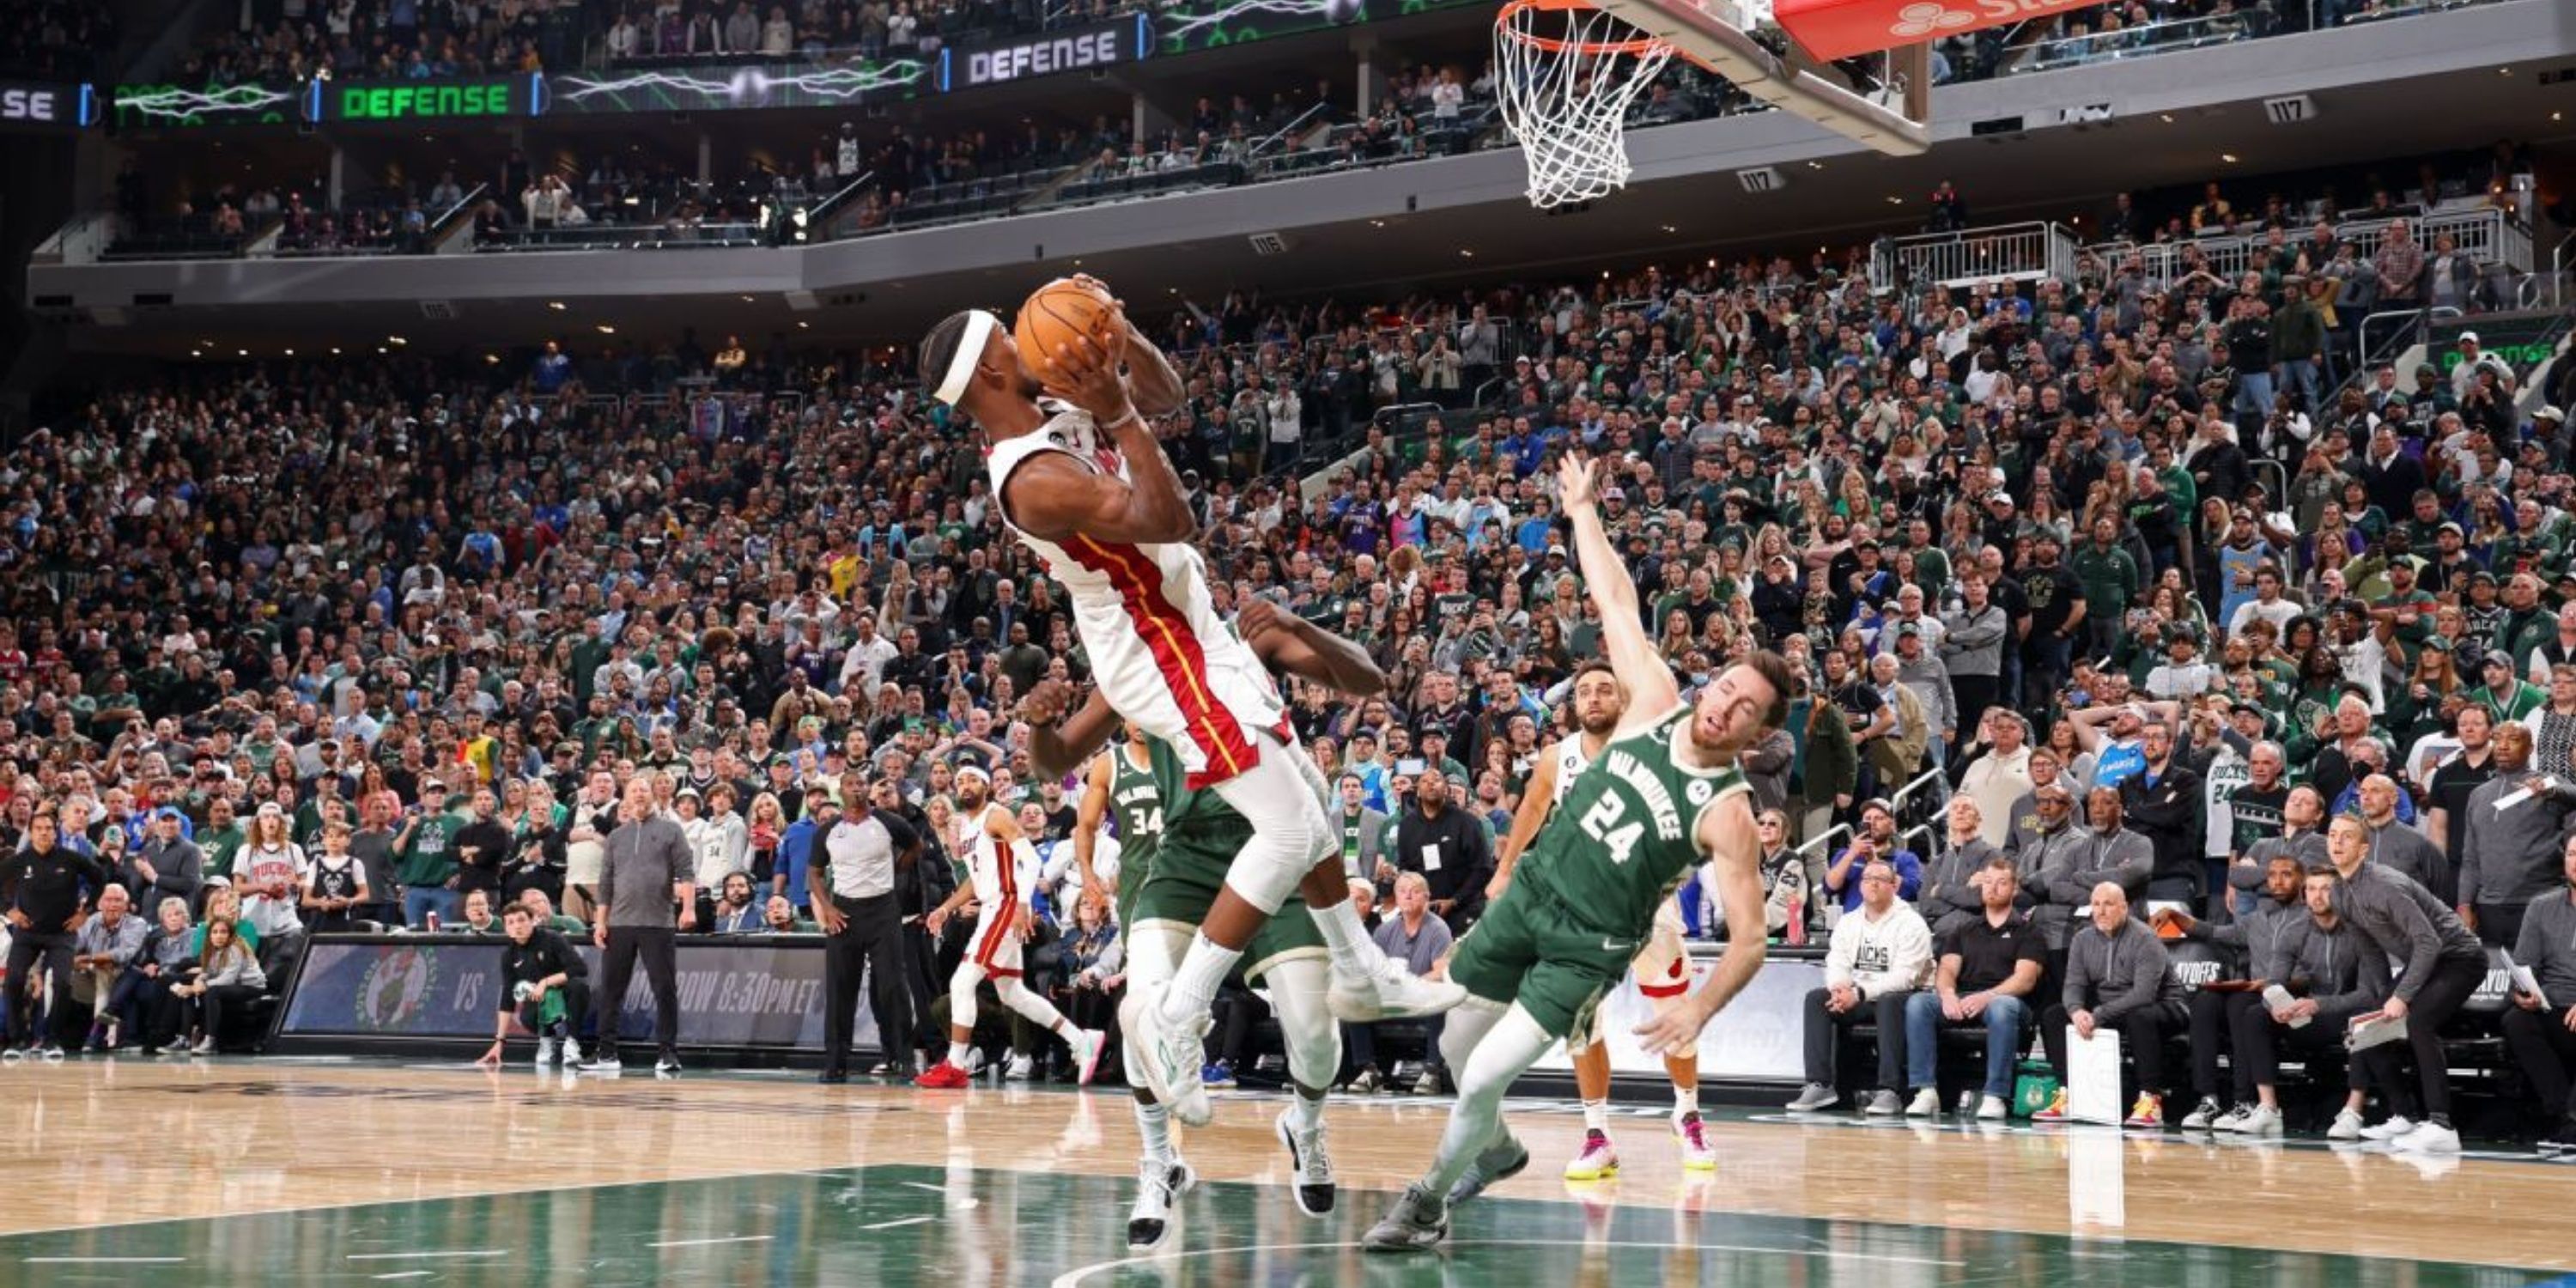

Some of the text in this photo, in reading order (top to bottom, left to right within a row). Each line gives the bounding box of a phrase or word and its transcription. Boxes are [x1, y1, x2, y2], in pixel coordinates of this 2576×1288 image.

[969, 31, 1116, 83] DEFENSE
[343, 84, 509, 118] DEFENSE
[2271, 99, 2301, 121] 117
[1743, 171, 1770, 190] 117
[1255, 236, 1281, 254] 116
[1607, 750, 1684, 841] MILWAUKEE
[1129, 805, 1166, 835] 34
[1580, 787, 1646, 866] 24
[453, 972, 485, 1012] VS
